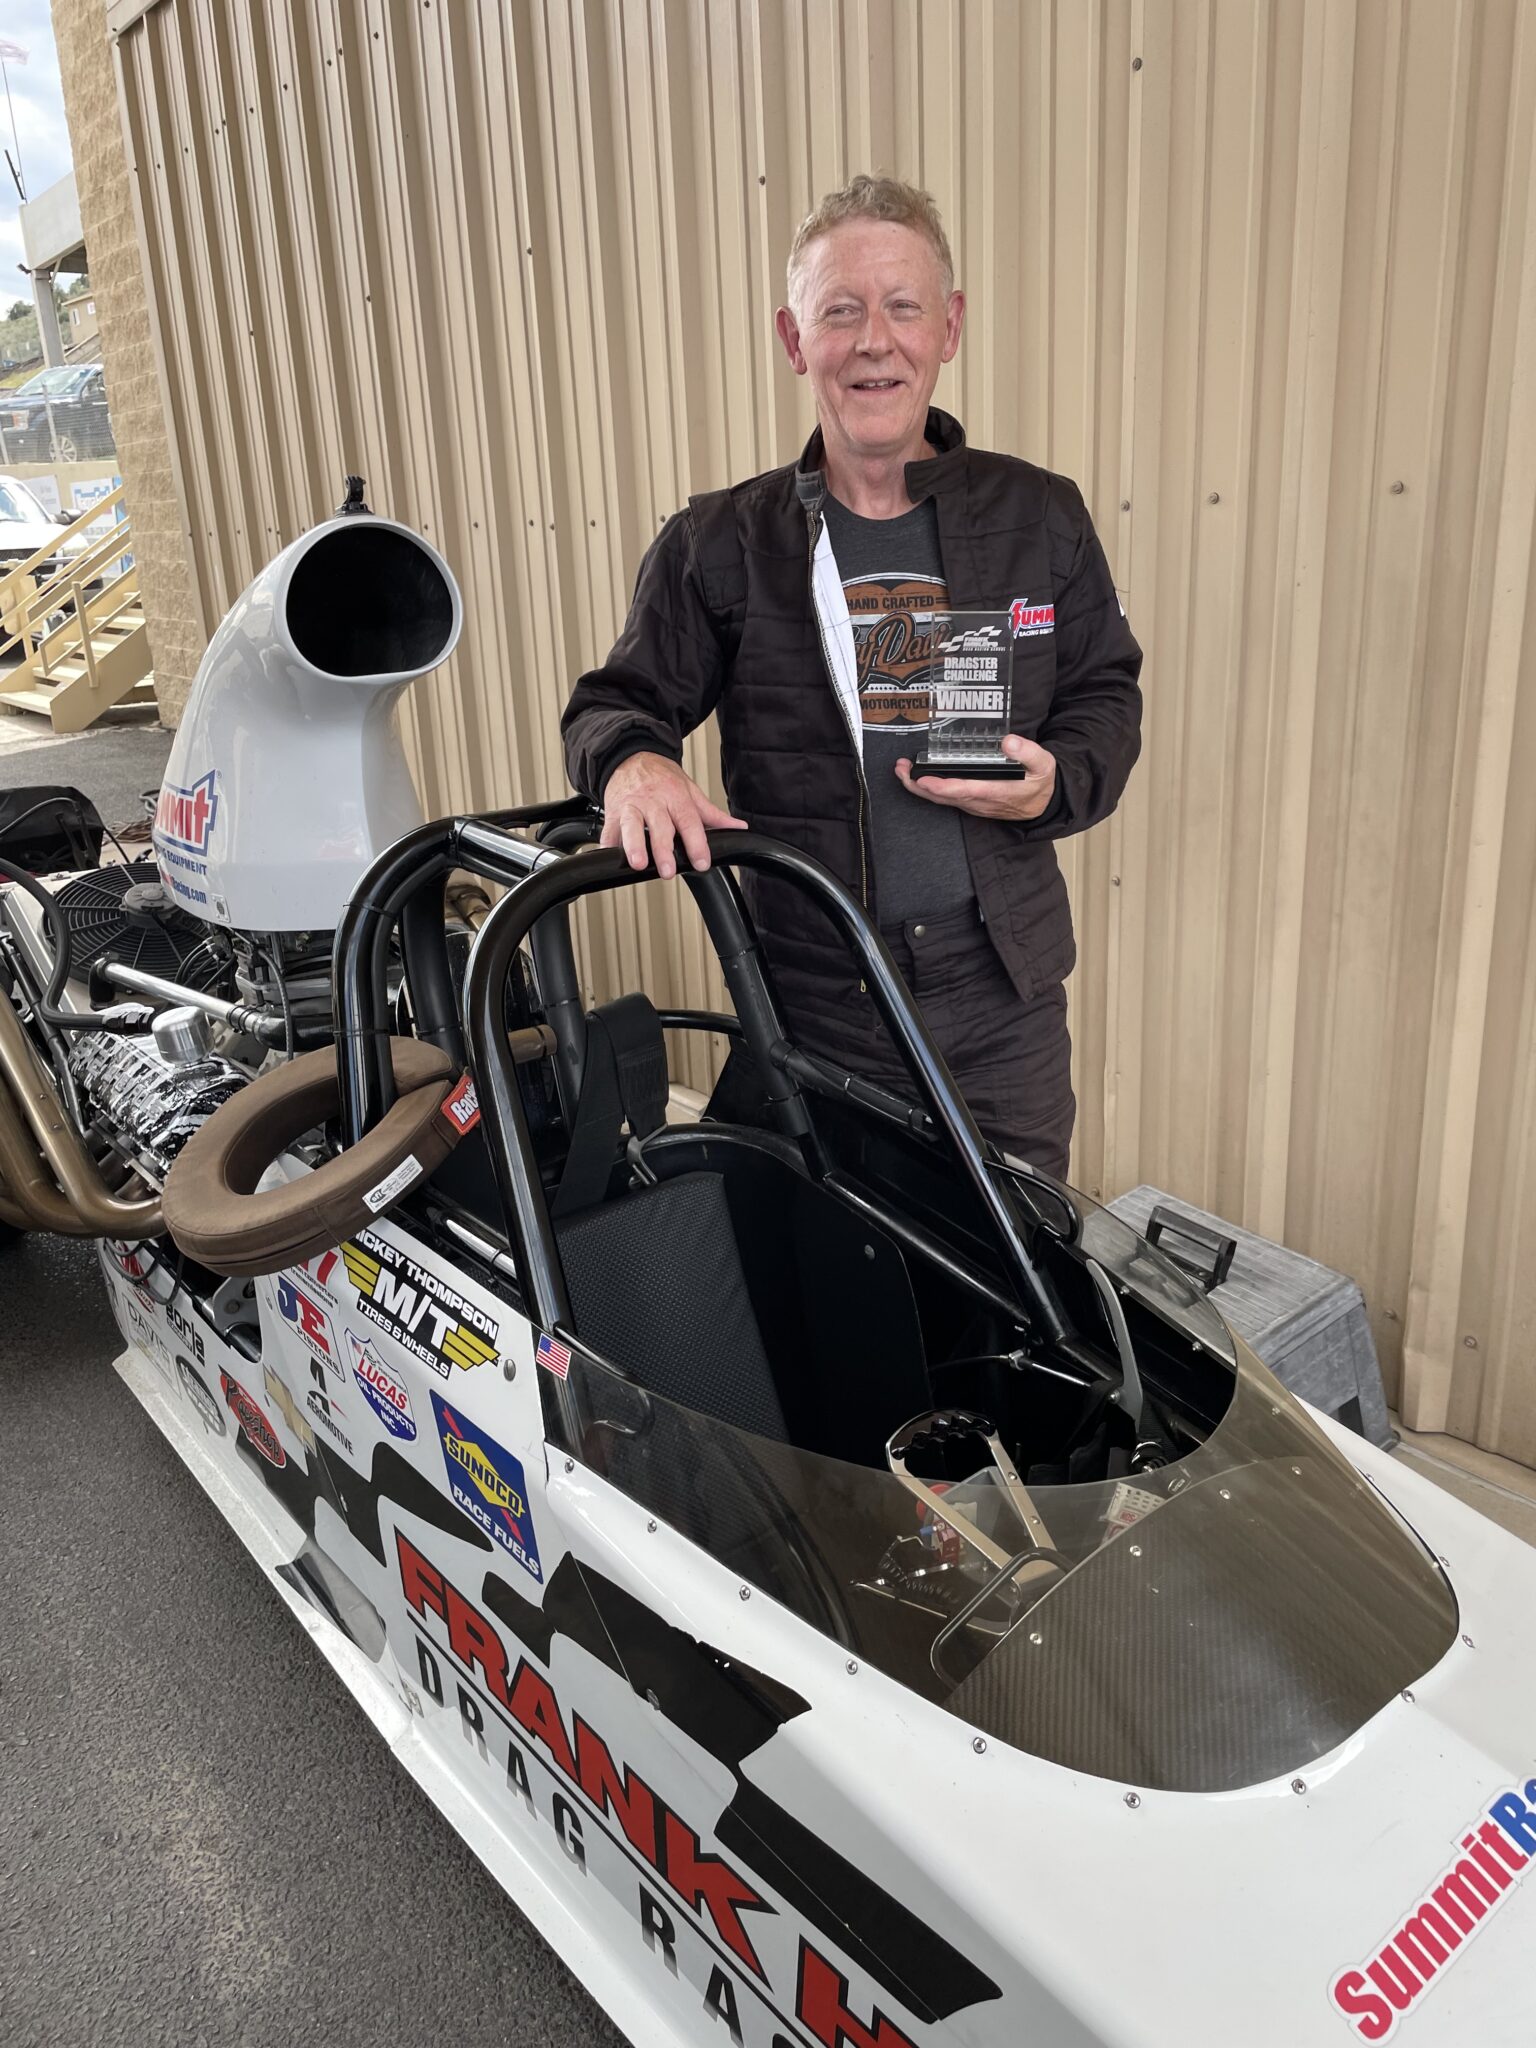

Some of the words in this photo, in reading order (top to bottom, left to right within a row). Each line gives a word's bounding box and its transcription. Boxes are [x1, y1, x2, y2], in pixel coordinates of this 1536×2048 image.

[848, 597, 879, 611] HAND
[883, 594, 935, 610] CRAFTED
[1010, 602, 1055, 633] SUMM
[944, 656, 998, 670] DRAGSTER
[944, 669, 998, 682] CHALLENGE
[936, 691, 1004, 711] WINNER
[167, 850, 207, 875] EQUIPMENT
[277, 1275, 330, 1355] JE
[372, 1266, 459, 1350] M/T
[406, 1259, 498, 1340] THOMPSON
[296, 1325, 340, 1375] PISTONS
[359, 1298, 393, 1331] TIRES
[391, 1327, 402, 1340] &
[401, 1331, 450, 1377] WHEELS
[357, 1376, 372, 1395] OIL
[371, 1389, 416, 1436] PRODUCTS
[358, 1358, 408, 1410] LUCAS
[307, 1397, 354, 1456] AEROMOTIVE
[448, 1437, 522, 1514] SUNOCO
[452, 1482, 491, 1530] RACE
[493, 1522, 540, 1576] FUELS
[394, 1524, 780, 1994] FRANK
[415, 1634, 588, 1877] DRAG
